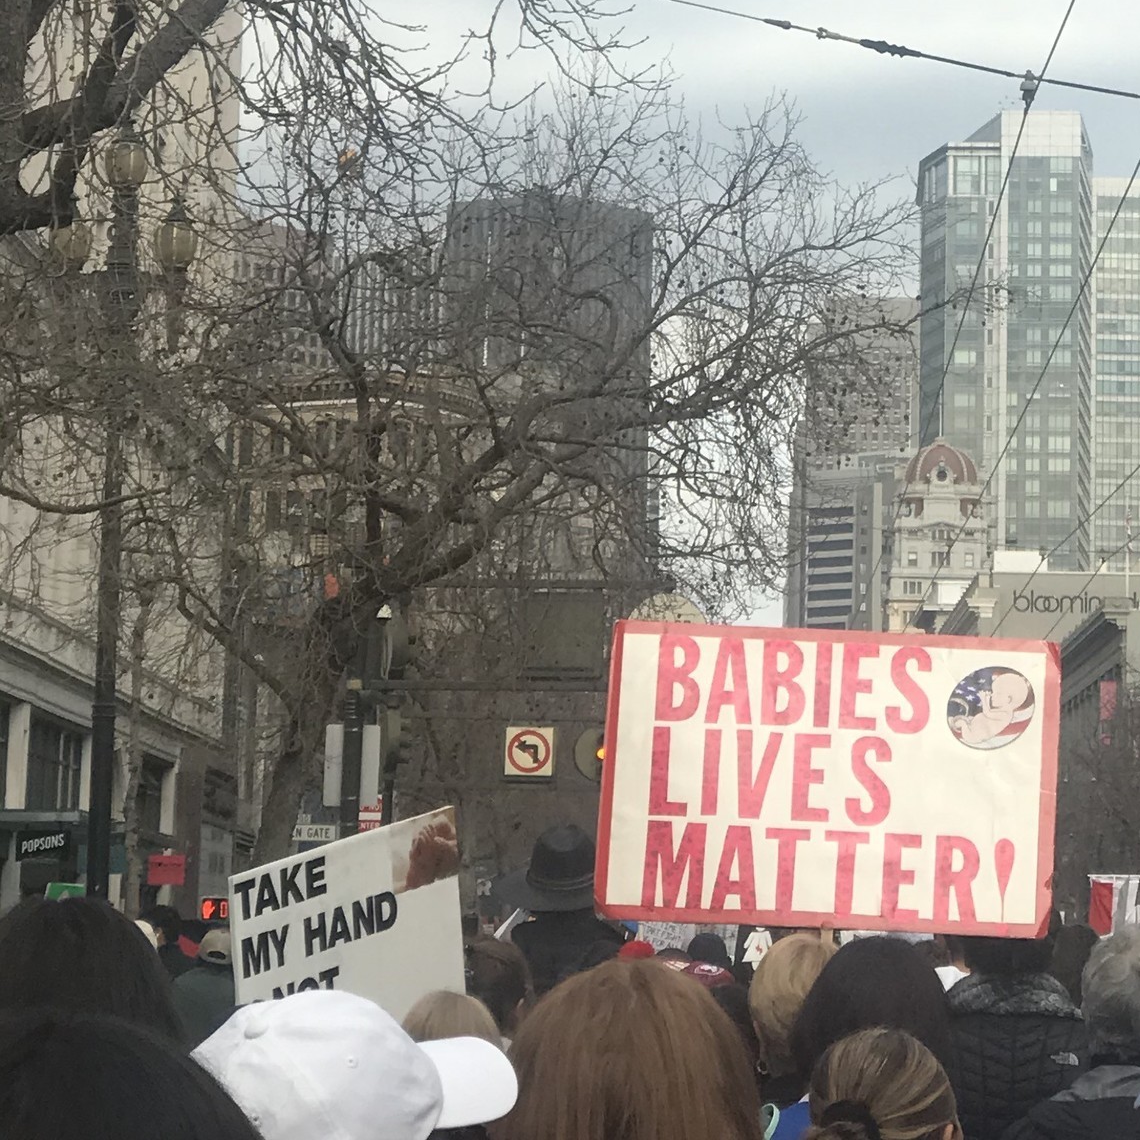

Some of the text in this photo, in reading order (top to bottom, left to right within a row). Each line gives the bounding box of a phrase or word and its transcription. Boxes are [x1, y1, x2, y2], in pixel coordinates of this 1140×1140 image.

[654, 634, 933, 735] BABIES
[648, 726, 892, 826] LIVES
[21, 833, 65, 854] POPSONS
[307, 827, 330, 839] GATE
[359, 821, 380, 831] NTER
[234, 855, 327, 921] TAKE
[640, 820, 1016, 935] MATTER!
[241, 891, 398, 979] MY HAND
